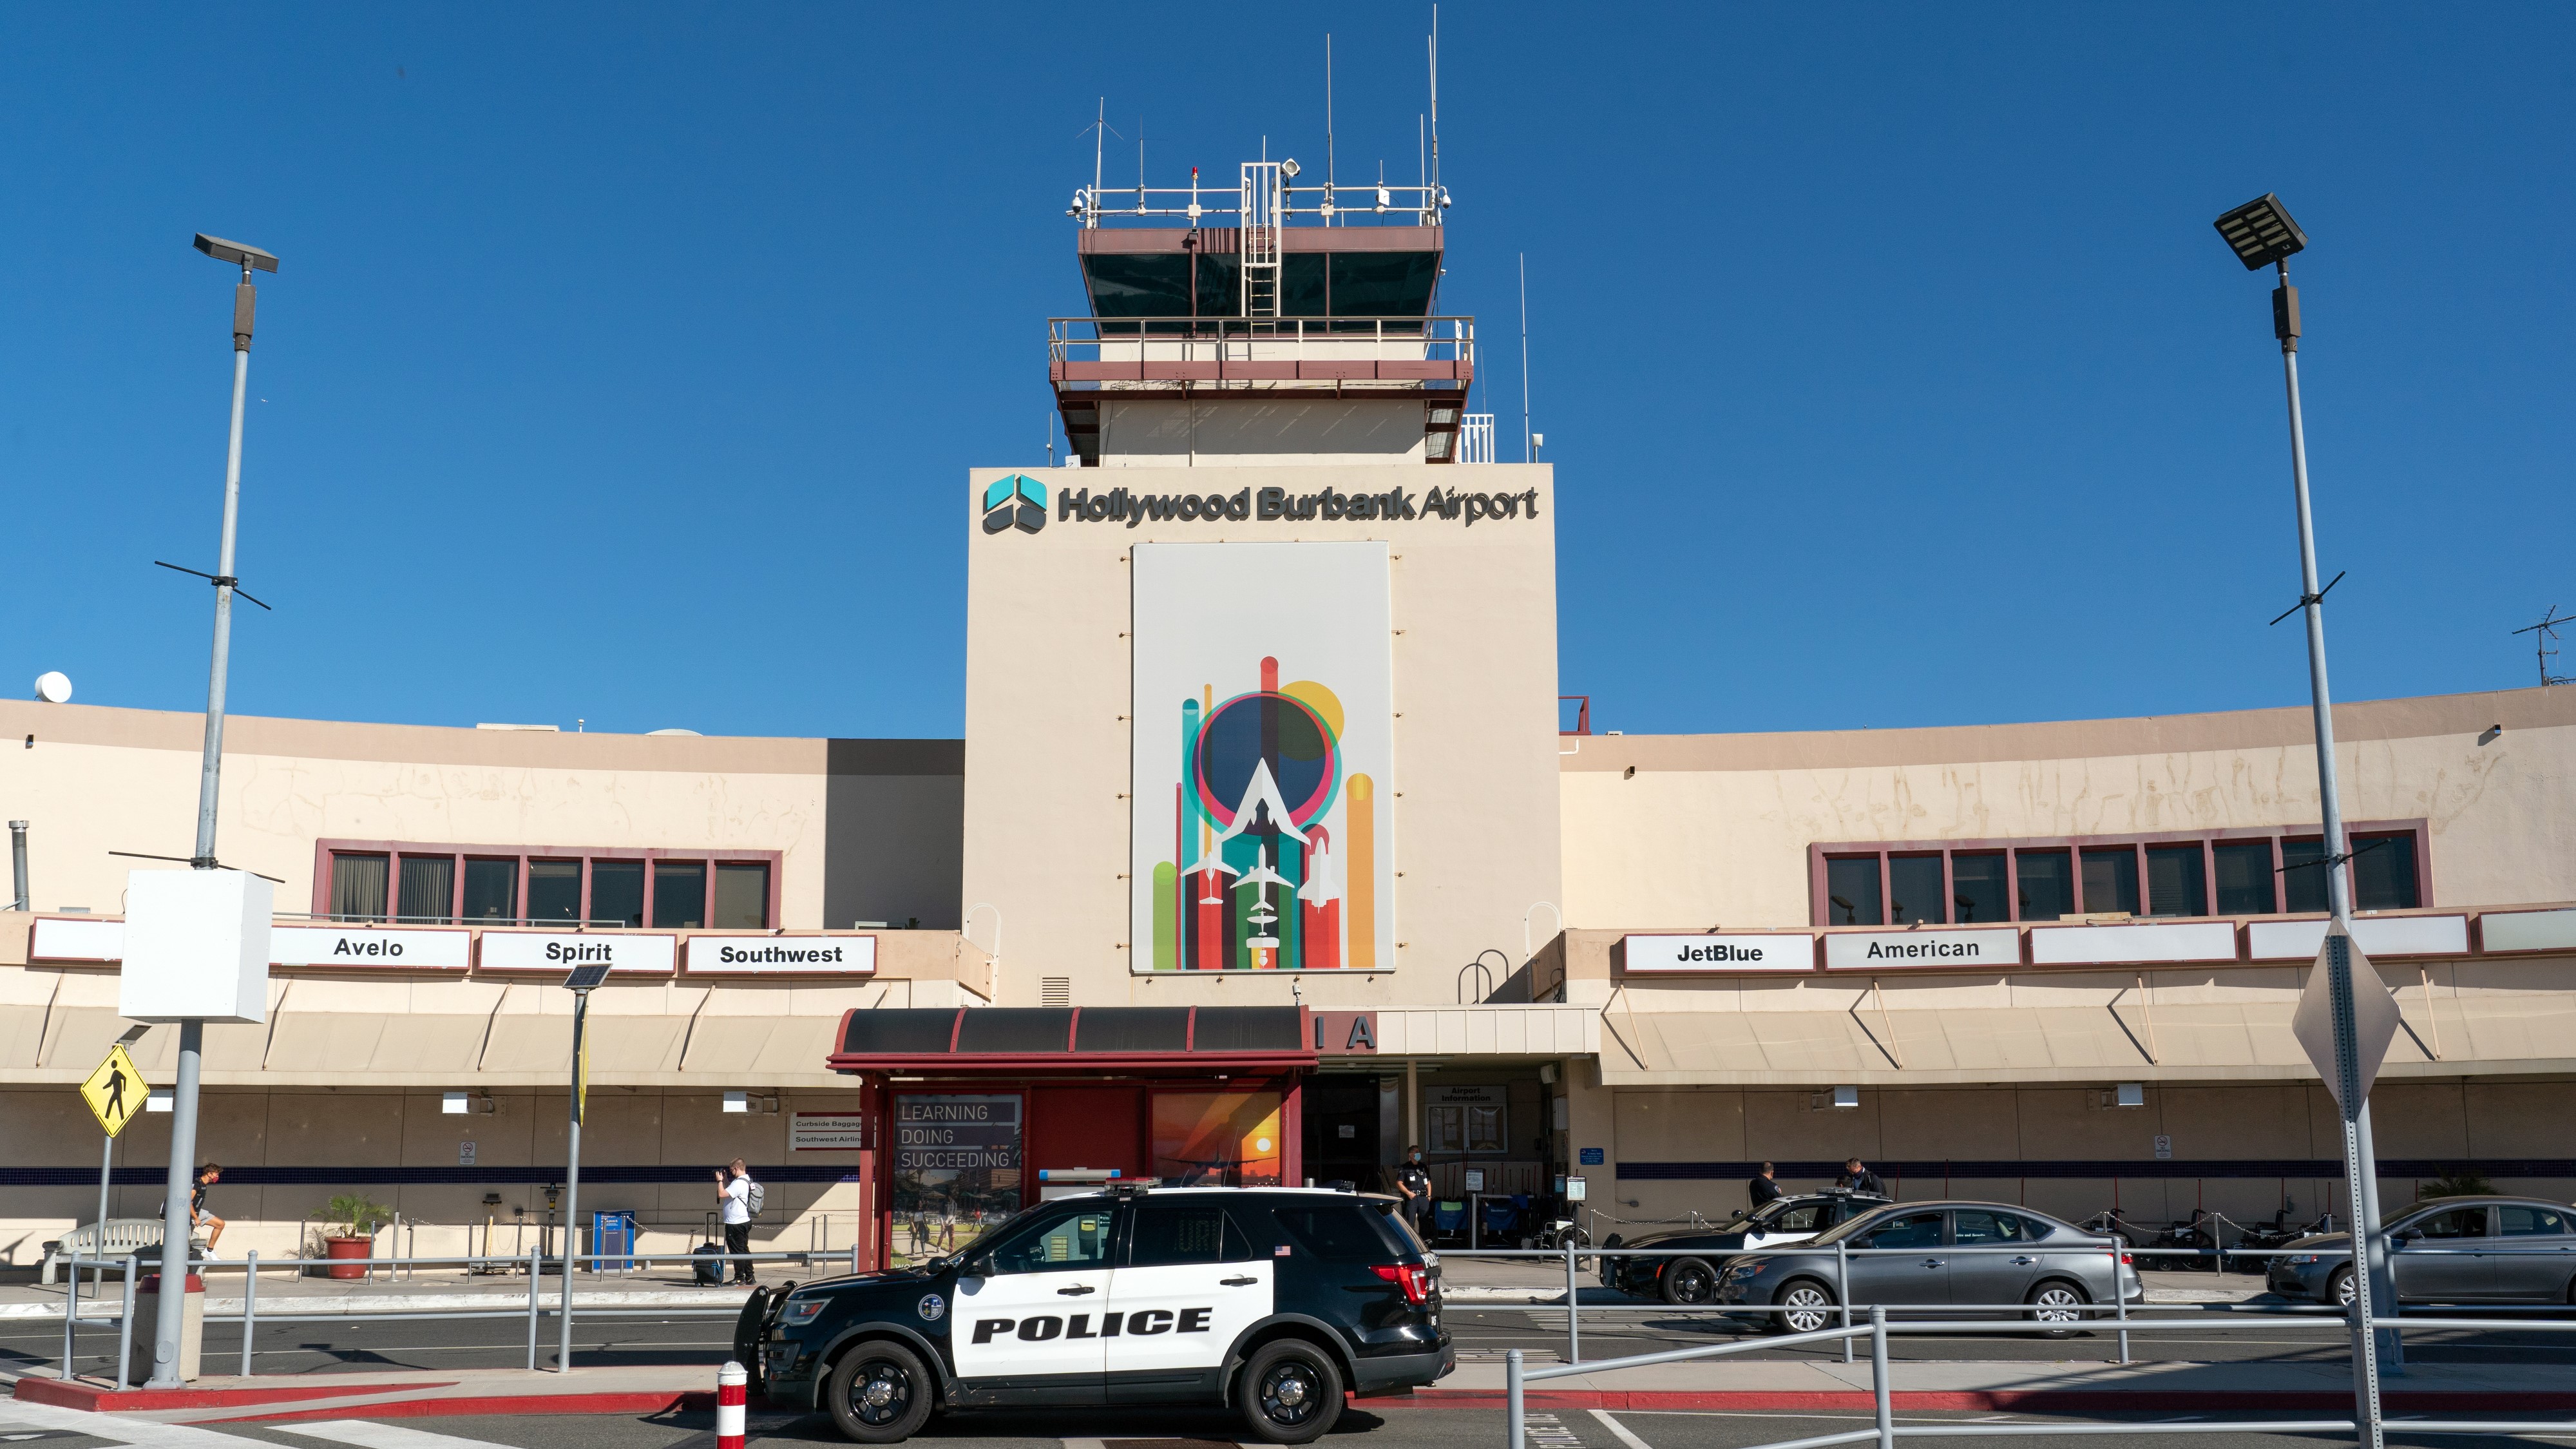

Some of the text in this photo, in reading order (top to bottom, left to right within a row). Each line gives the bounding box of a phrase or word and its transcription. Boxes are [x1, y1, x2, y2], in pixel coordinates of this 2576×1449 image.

[1059, 486, 1539, 528] Hollywood Burbank Airport
[333, 938, 403, 957] Avelo
[546, 942, 612, 964] Spirit
[720, 946, 843, 963] Southwest
[1677, 945, 1763, 962] JetBlue
[1867, 940, 1980, 959] American
[1451, 1087, 1481, 1095] Airport
[901, 1105, 988, 1120] LEARNING
[901, 1129, 953, 1145] DOING
[901, 1153, 1009, 1168] SUCCEEDING
[972, 1307, 1213, 1345] POLICE
